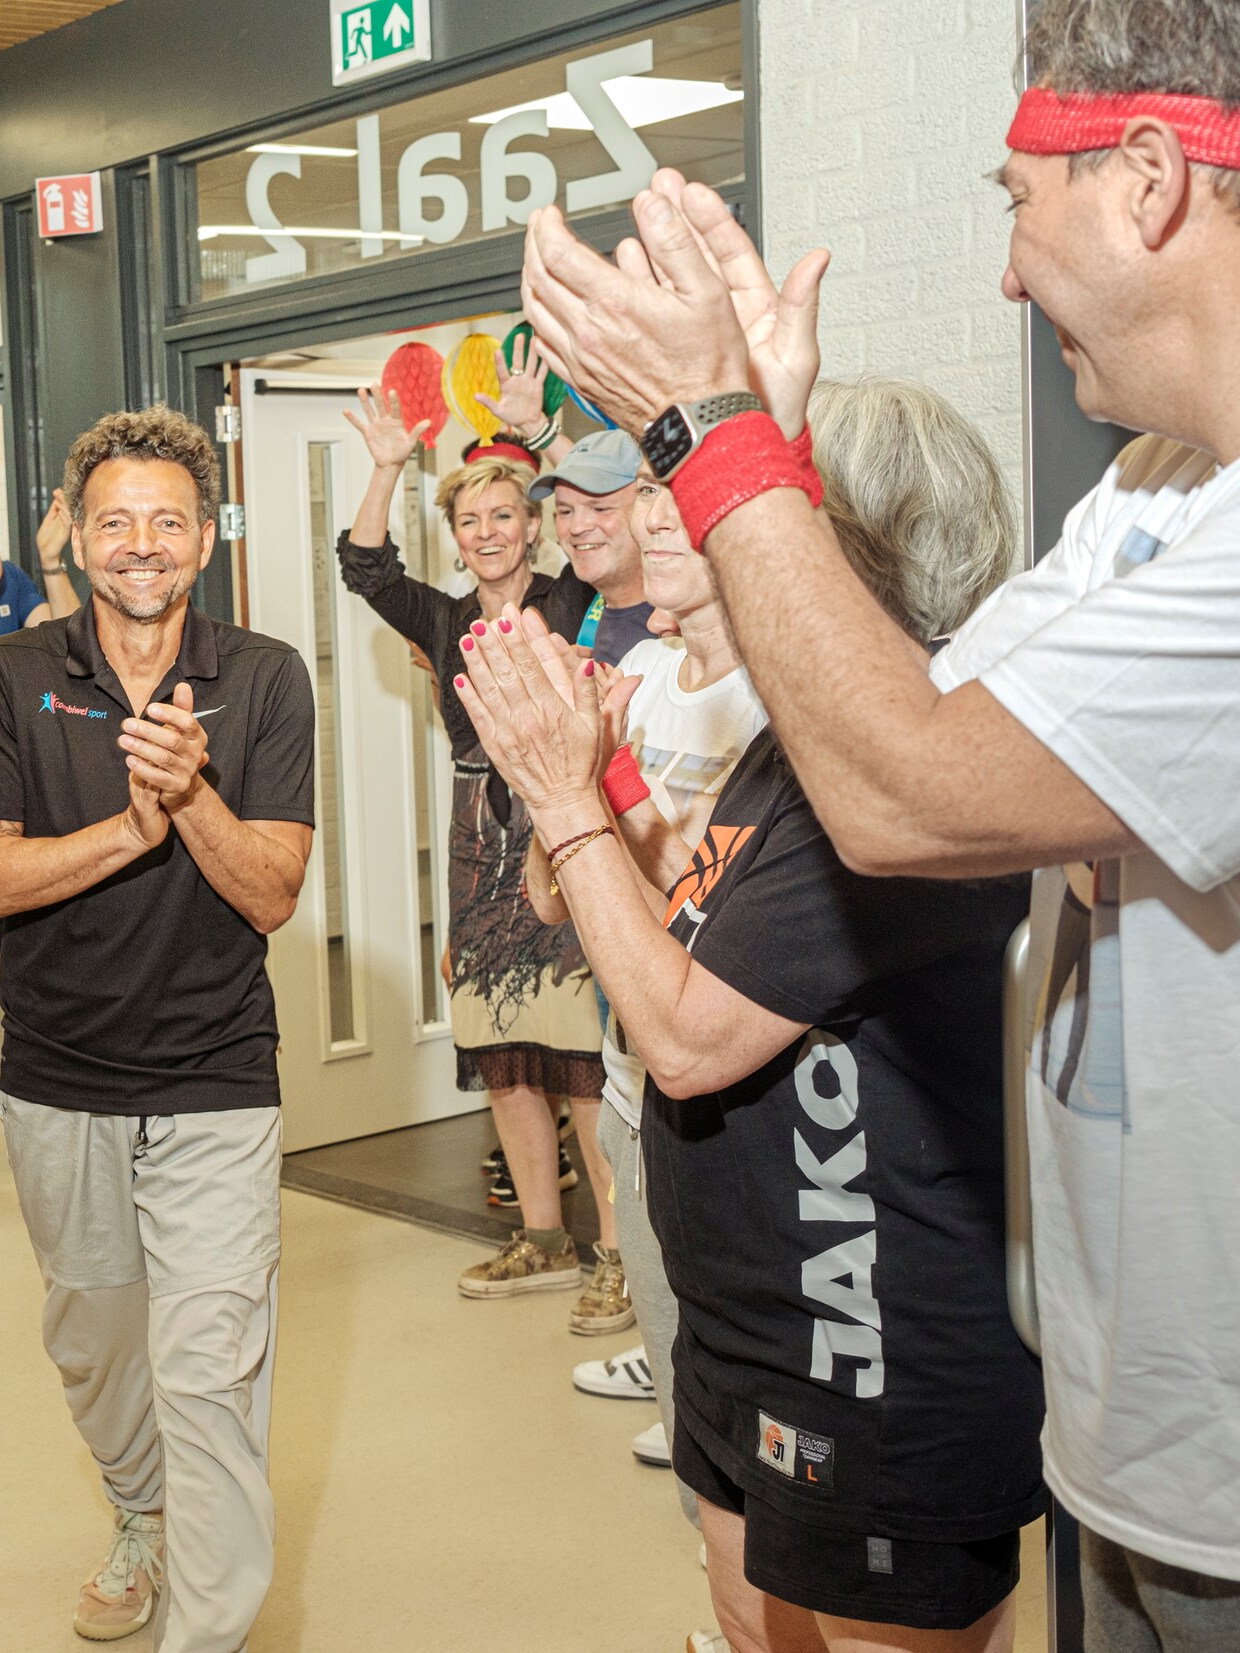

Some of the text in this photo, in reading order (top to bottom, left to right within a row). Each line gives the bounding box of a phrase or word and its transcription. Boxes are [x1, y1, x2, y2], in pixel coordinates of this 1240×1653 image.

[794, 1028, 884, 1398] JAKO
[797, 1435, 830, 1454] JAKO
[807, 1464, 818, 1482] L
